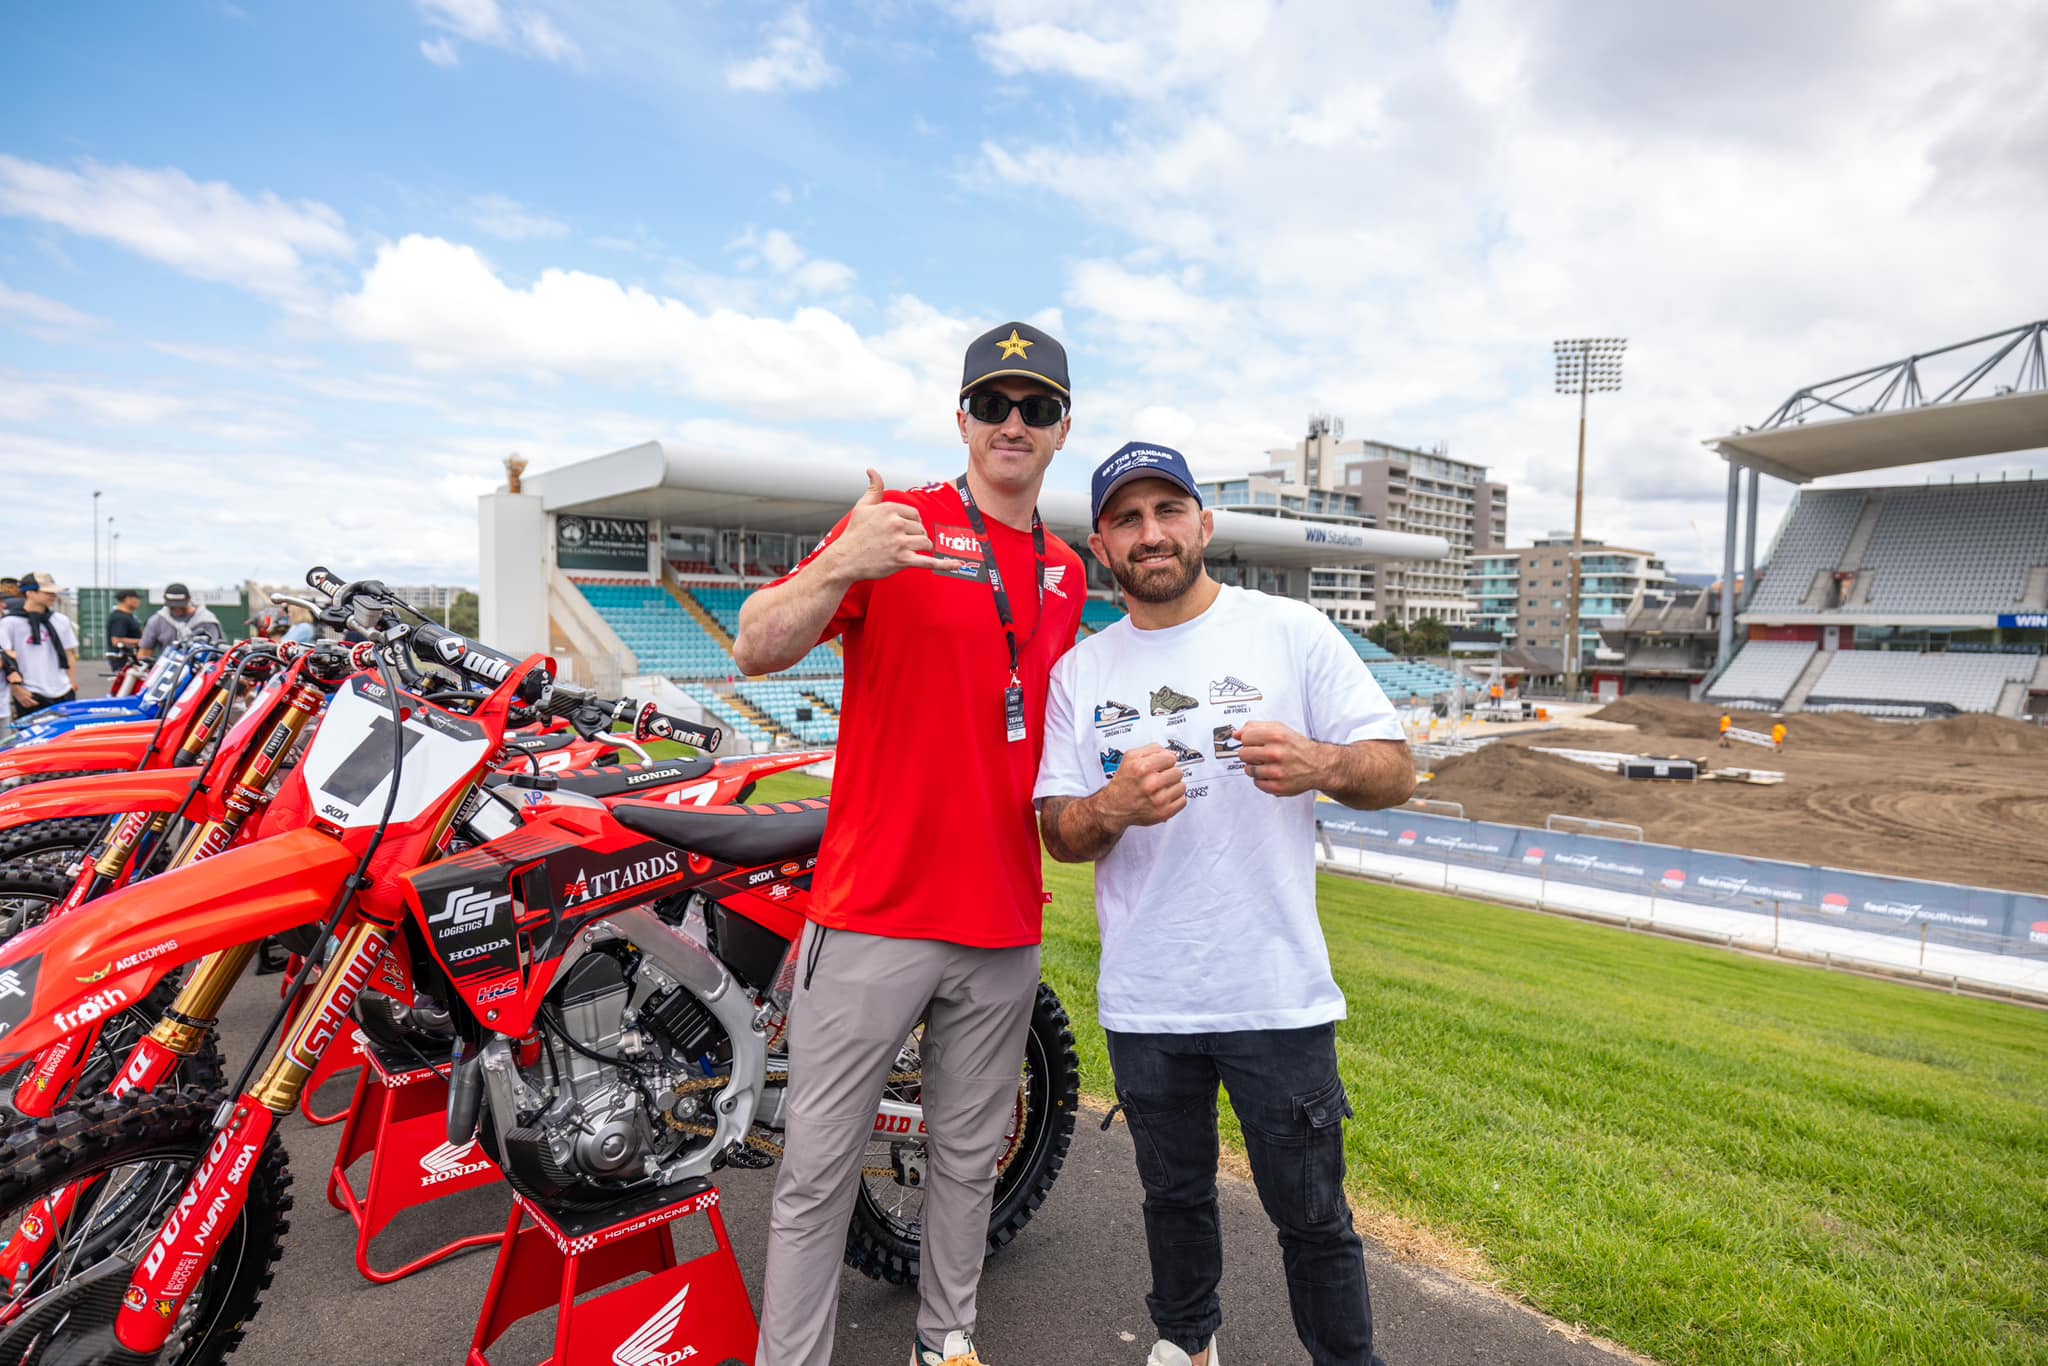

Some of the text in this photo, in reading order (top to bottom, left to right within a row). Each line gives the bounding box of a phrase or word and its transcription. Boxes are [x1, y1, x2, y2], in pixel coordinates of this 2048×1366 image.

[1131, 449, 1173, 461] STANDARD
[586, 520, 646, 536] TYNAN
[1304, 527, 1363, 547] WIN Stadium
[2014, 614, 2048, 628] WIN
[320, 715, 425, 808] 1
[626, 768, 682, 785] HONDA
[523, 790, 544, 806] VP
[321, 804, 350, 823] SKDA
[564, 851, 679, 908] ATTARDS
[748, 869, 775, 886] SKDA
[438, 919, 483, 938] LOGISTICS
[448, 937, 512, 962] HONDA
[873, 1113, 912, 1134] DID
[227, 1144, 257, 1185] SKDA
[421, 1160, 492, 1187] HONDA
[143, 1129, 234, 1280] DUNLO
[604, 1204, 690, 1241] Honda RACING
[173, 1258, 199, 1291] BOOTS
